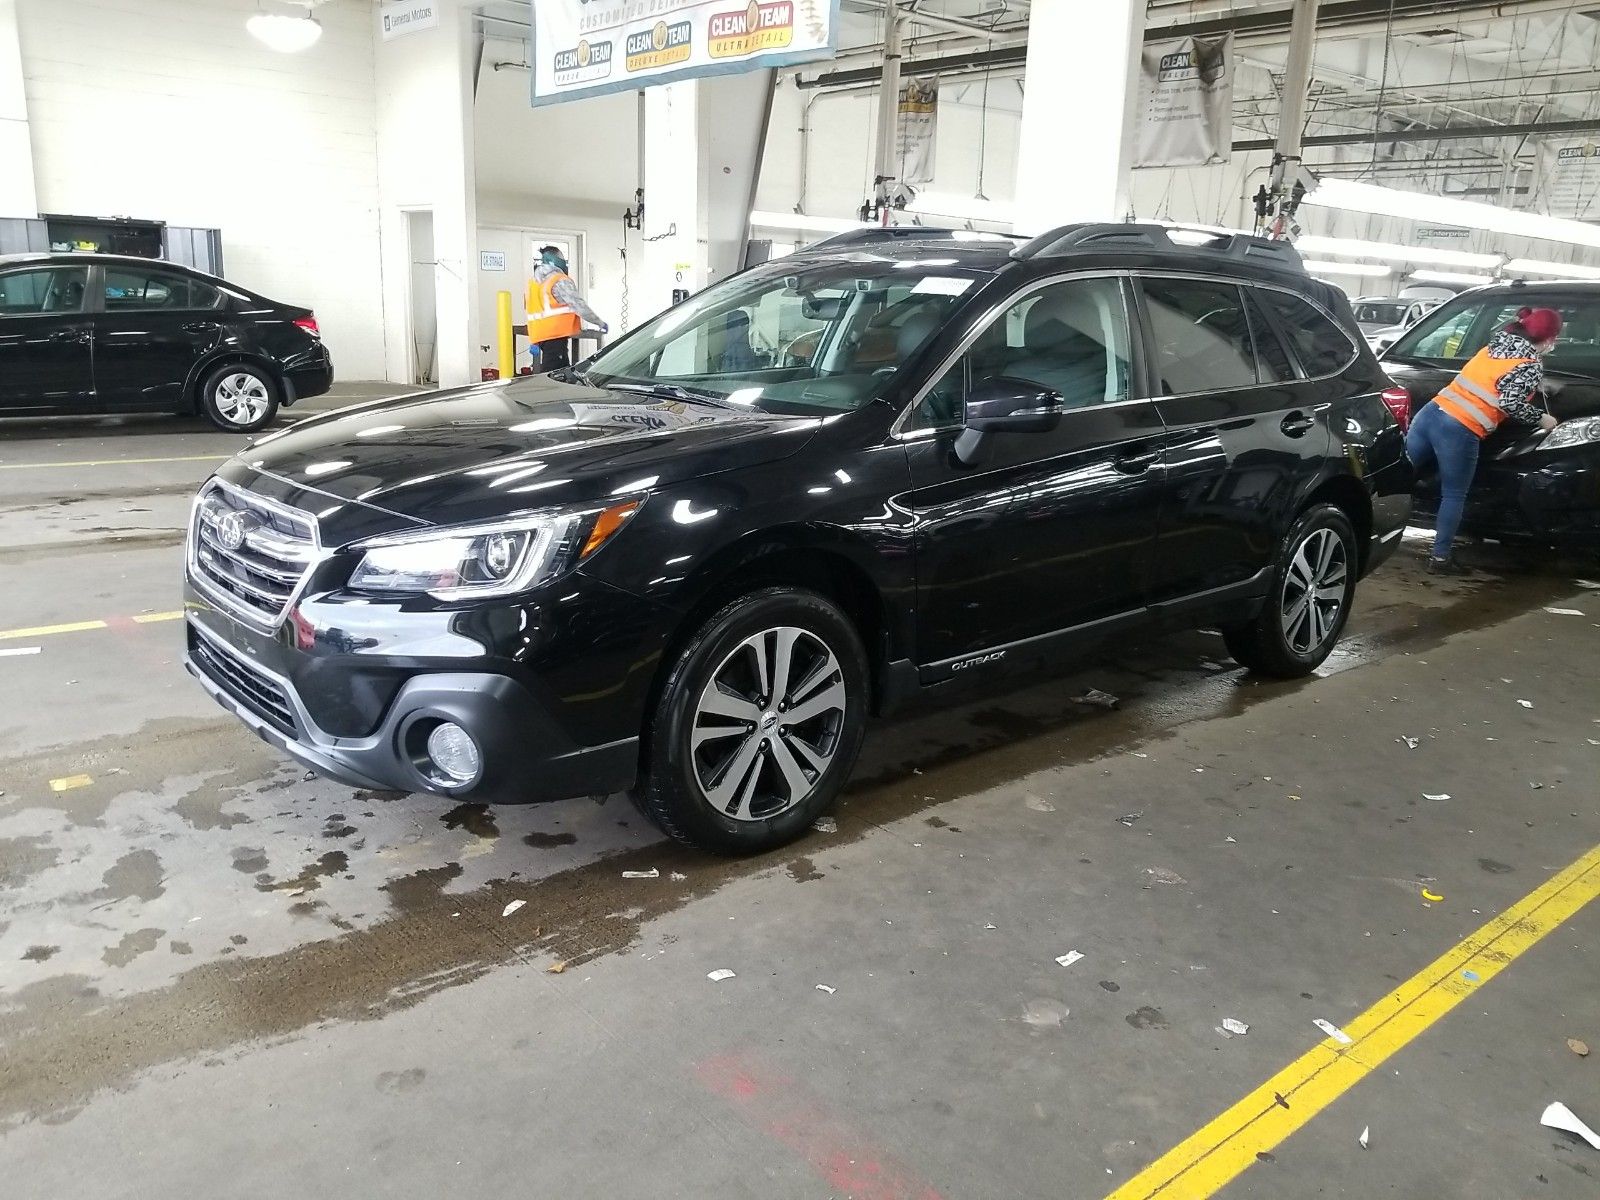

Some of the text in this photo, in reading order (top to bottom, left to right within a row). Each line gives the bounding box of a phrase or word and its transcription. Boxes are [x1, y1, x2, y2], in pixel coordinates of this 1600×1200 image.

[391, 8, 431, 26] General Motors
[712, 5, 789, 36] CLEAN TEAM
[628, 24, 689, 53] CLEAN TEAM
[716, 31, 784, 52] ULTRA DETAIL
[555, 44, 611, 70] CLEAN TEAM
[1162, 55, 1189, 69] CLEAN
[1162, 70, 1190, 79] VALUE
[1560, 148, 1581, 157] CLEAN
[1429, 229, 1469, 238] Enterprise
[952, 650, 1006, 671] OUTBACK
